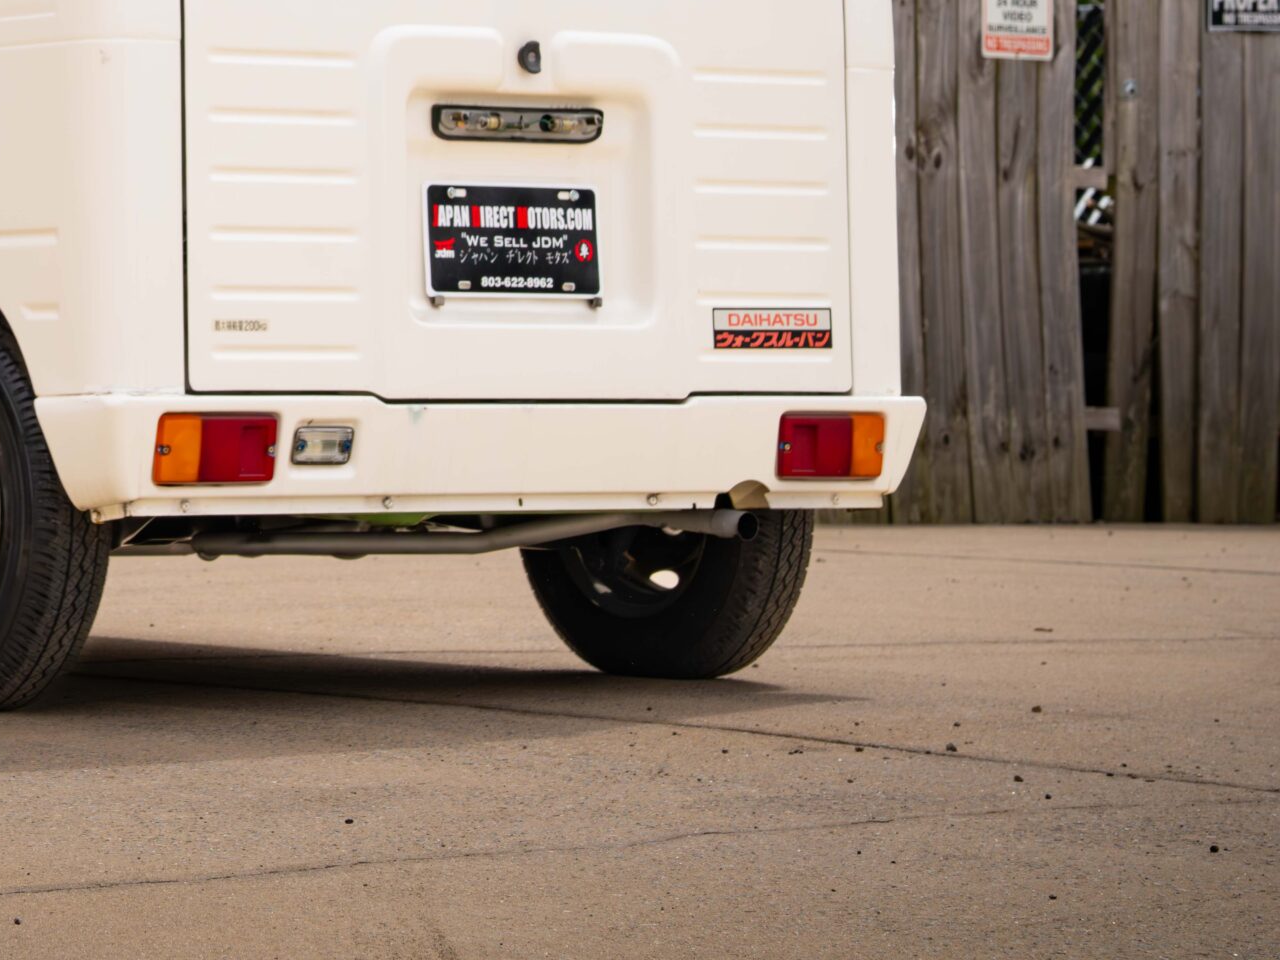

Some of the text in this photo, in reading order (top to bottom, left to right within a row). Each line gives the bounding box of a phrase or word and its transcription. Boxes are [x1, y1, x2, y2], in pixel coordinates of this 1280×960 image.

[1003, 10, 1033, 22] VIDEO
[988, 24, 1048, 36] SURVEILLANCE
[481, 275, 554, 289] 803-622-8962
[727, 312, 818, 327] DAIHATSU
